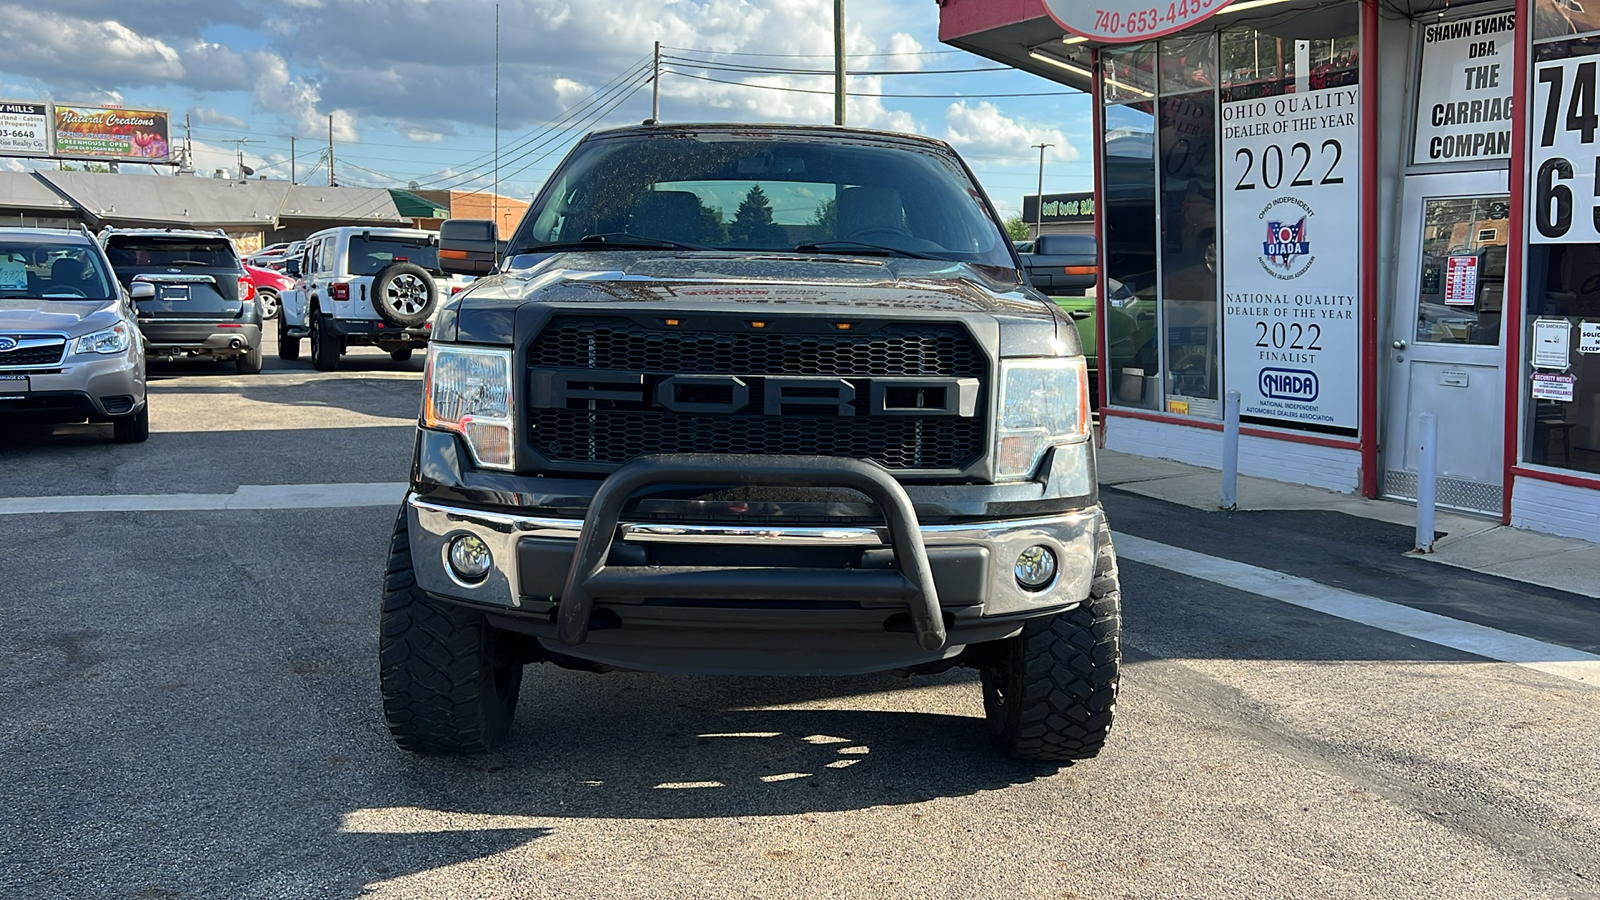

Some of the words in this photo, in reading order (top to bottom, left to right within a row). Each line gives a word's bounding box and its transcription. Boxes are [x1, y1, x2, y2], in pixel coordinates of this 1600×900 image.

[1426, 21, 1473, 44] SHAWN
[1474, 15, 1515, 36] EVANS
[1469, 40, 1498, 58] DBA.
[1464, 64, 1500, 90] THE
[1224, 102, 1266, 120] OHIO
[1274, 90, 1357, 116] QUALITY
[61, 112, 104, 123] Natural
[106, 114, 154, 126] Creations
[1225, 122, 1270, 139] DEALER
[1273, 120, 1288, 134] OF
[1292, 117, 1317, 131] THE
[1320, 112, 1354, 128] YEAR
[1235, 139, 1344, 190] 2022
[1259, 203, 1272, 219] OHIO
[1273, 197, 1315, 217] INDEPENDENT
[1536, 157, 1600, 238] 6
[1269, 243, 1302, 254] OIADA
[1226, 294, 1289, 304] NATIONAL
[1295, 295, 1354, 306] QUALITY
[1228, 307, 1269, 316] DEALER
[1274, 308, 1288, 317] OF
[1293, 309, 1315, 318] THE
[1321, 310, 1352, 319] YEAR
[1256, 322, 1322, 350] 2022
[1260, 351, 1316, 363] FINALIST
[541, 371, 979, 417] FORD
[1263, 374, 1313, 396] NIADA
[1246, 407, 1276, 416] AUTOMOBILE
[1277, 410, 1298, 418] DEALERS
[1299, 412, 1334, 422] ASSOCIATION
[1285, 403, 1318, 412] INDEPENDENT
